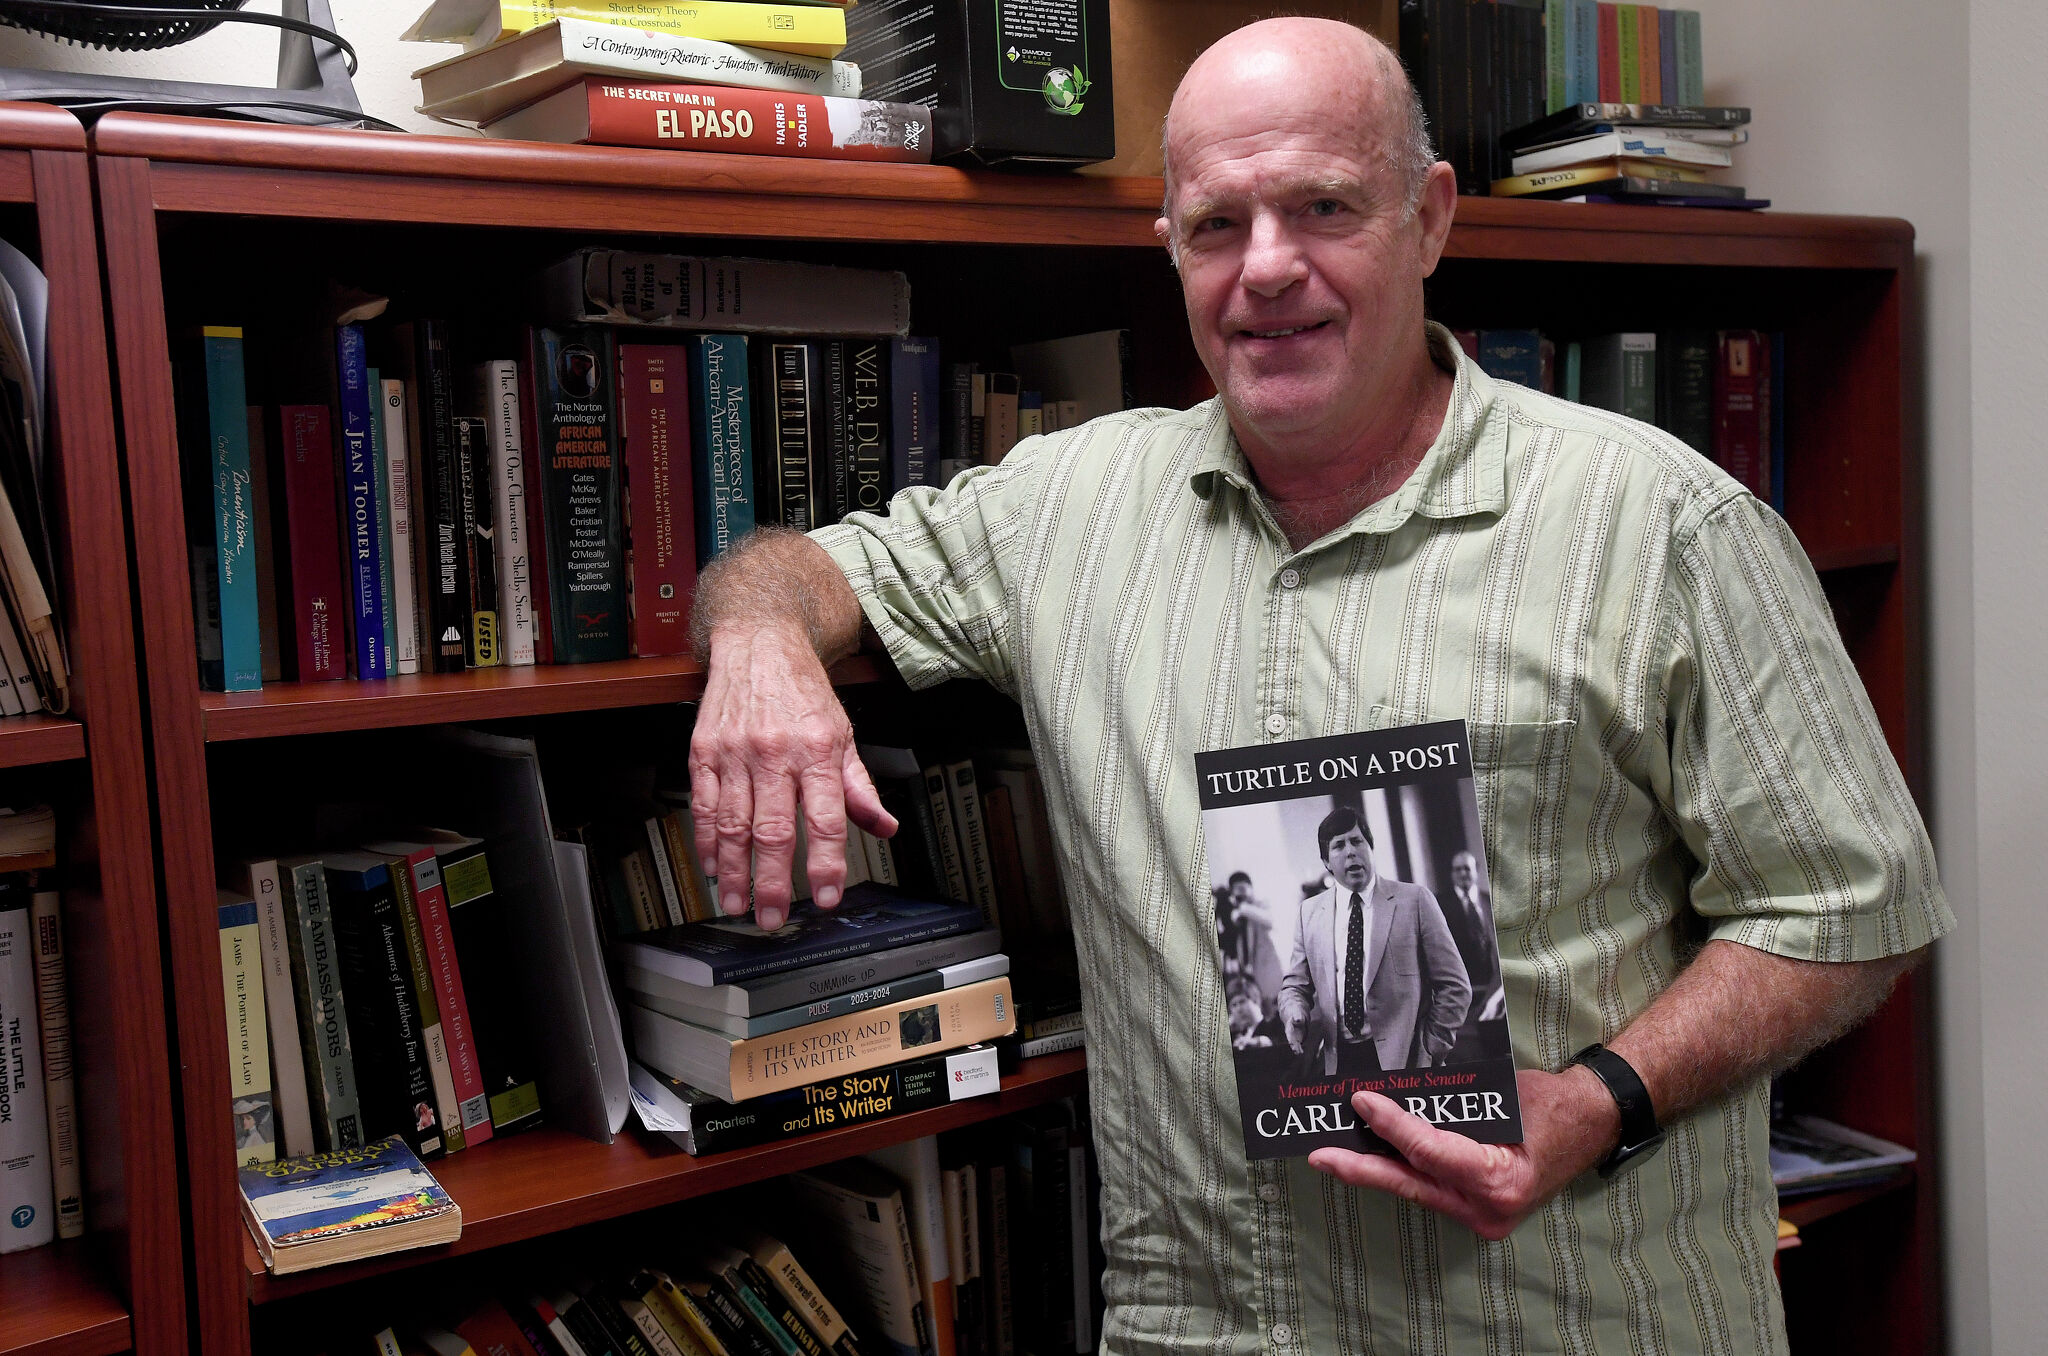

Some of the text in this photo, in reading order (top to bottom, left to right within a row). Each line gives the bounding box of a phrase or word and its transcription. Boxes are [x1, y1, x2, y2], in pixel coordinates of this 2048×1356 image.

[608, 3, 698, 18] Short Story Theory
[630, 17, 682, 29] Crossroads
[582, 37, 598, 50] A
[601, 39, 673, 66] Contemporary
[671, 48, 710, 66] Rhetoric
[787, 64, 826, 82] Edition
[1022, 49, 1052, 57] DIAMOND
[602, 86, 716, 107] THE SECRET WAR IN
[656, 110, 753, 138] EL PASO
[775, 102, 785, 144] HARRIS
[798, 103, 807, 148] SADLER
[622, 267, 637, 306] Black
[640, 264, 655, 312] Writers
[659, 281, 672, 296] of
[675, 262, 690, 318] America
[500, 367, 516, 390] The
[501, 392, 519, 438] Content
[553, 413, 607, 425] Anthology of
[555, 403, 602, 412] The Norton
[559, 425, 602, 440] AFRICAN
[724, 385, 748, 504] Masterpieces of
[847, 414, 855, 472] READER
[855, 344, 881, 514] W.E.B. DU BOI
[345, 429, 366, 474] JEAN
[504, 441, 519, 454] of
[555, 440, 607, 455] AMERICAN
[707, 340, 731, 551] African-American Literatur
[506, 456, 520, 481] Our
[552, 455, 612, 470] LITERATURE
[572, 474, 596, 483] Gates
[392, 475, 407, 511] MORRISON
[571, 485, 597, 495] McKay
[650, 408, 665, 568] OF AFRICAN AMERICAN LITERATURE
[659, 408, 672, 556] THE PRENTICE HALL ANTHOLOGY
[230, 468, 250, 557] Romanticism
[506, 484, 522, 544] Character
[568, 496, 601, 505] Andrews
[574, 507, 597, 515] Baker
[353, 481, 372, 560] TOOMER
[569, 517, 603, 526] Christian
[575, 528, 599, 537] Foster
[438, 524, 457, 594] Zora Neale Hurston
[569, 538, 606, 548] McDowell
[571, 550, 605, 560] O'Meally
[507, 556, 526, 593] Shelby
[568, 560, 610, 571] Rampersad
[576, 572, 604, 582] Spillers
[361, 564, 374, 615] READER
[568, 582, 611, 592] Yarborough
[513, 595, 529, 630] Steele
[310, 612, 323, 672] College Editions
[319, 613, 331, 671] Modern Library
[479, 616, 492, 659] USED
[576, 631, 609, 641] NORTON
[368, 637, 377, 670] OXFORD
[1207, 743, 1460, 796] TURTLE ON A POST
[266, 902, 279, 951] THE AMERICAN
[397, 867, 428, 992] Adventures of Huckleberry Finn
[233, 937, 244, 966] JAMES
[303, 874, 342, 1058] THE AMBASSADORS
[236, 972, 246, 993] THE
[381, 923, 417, 1063] Adventures of Huckleberry Finn
[428, 896, 473, 1086] THE ADVENTURES OF TOM SAWYER
[808, 968, 876, 995] SUMMING UP
[850, 986, 891, 1006] 2023-2024
[237, 994, 249, 1038] PORTRAIT
[808, 1002, 830, 1017] PULSE
[9, 1017, 25, 1094] THE LITTLE,
[45, 1023, 73, 1083] FICTION
[241, 1040, 250, 1052] OF
[432, 1033, 443, 1063] Twain
[763, 1041, 799, 1062] THE
[802, 1028, 852, 1053] STORY
[855, 1019, 891, 1041] AND
[242, 1062, 253, 1087] LADY
[746, 1051, 755, 1083] CHARTERS
[764, 1060, 789, 1078] ITS
[792, 1043, 856, 1074] WRITER
[0, 1047, 12, 1123] HANDBOOK
[334, 1066, 346, 1098] JAMES
[802, 1074, 891, 1106] The Story
[903, 1071, 937, 1083] COMPACT
[904, 1081, 924, 1090] TENTH
[905, 1087, 932, 1097] EDITION
[1278, 1071, 1478, 1101] Memoir of Texas State Senator
[705, 1113, 757, 1134] Charters
[783, 1094, 893, 1132] and Its Writer
[1256, 1091, 1511, 1138] CARL RKER
[265, 1150, 383, 1178] GATSBY
[781, 1263, 832, 1327] A Farewell to Arms
